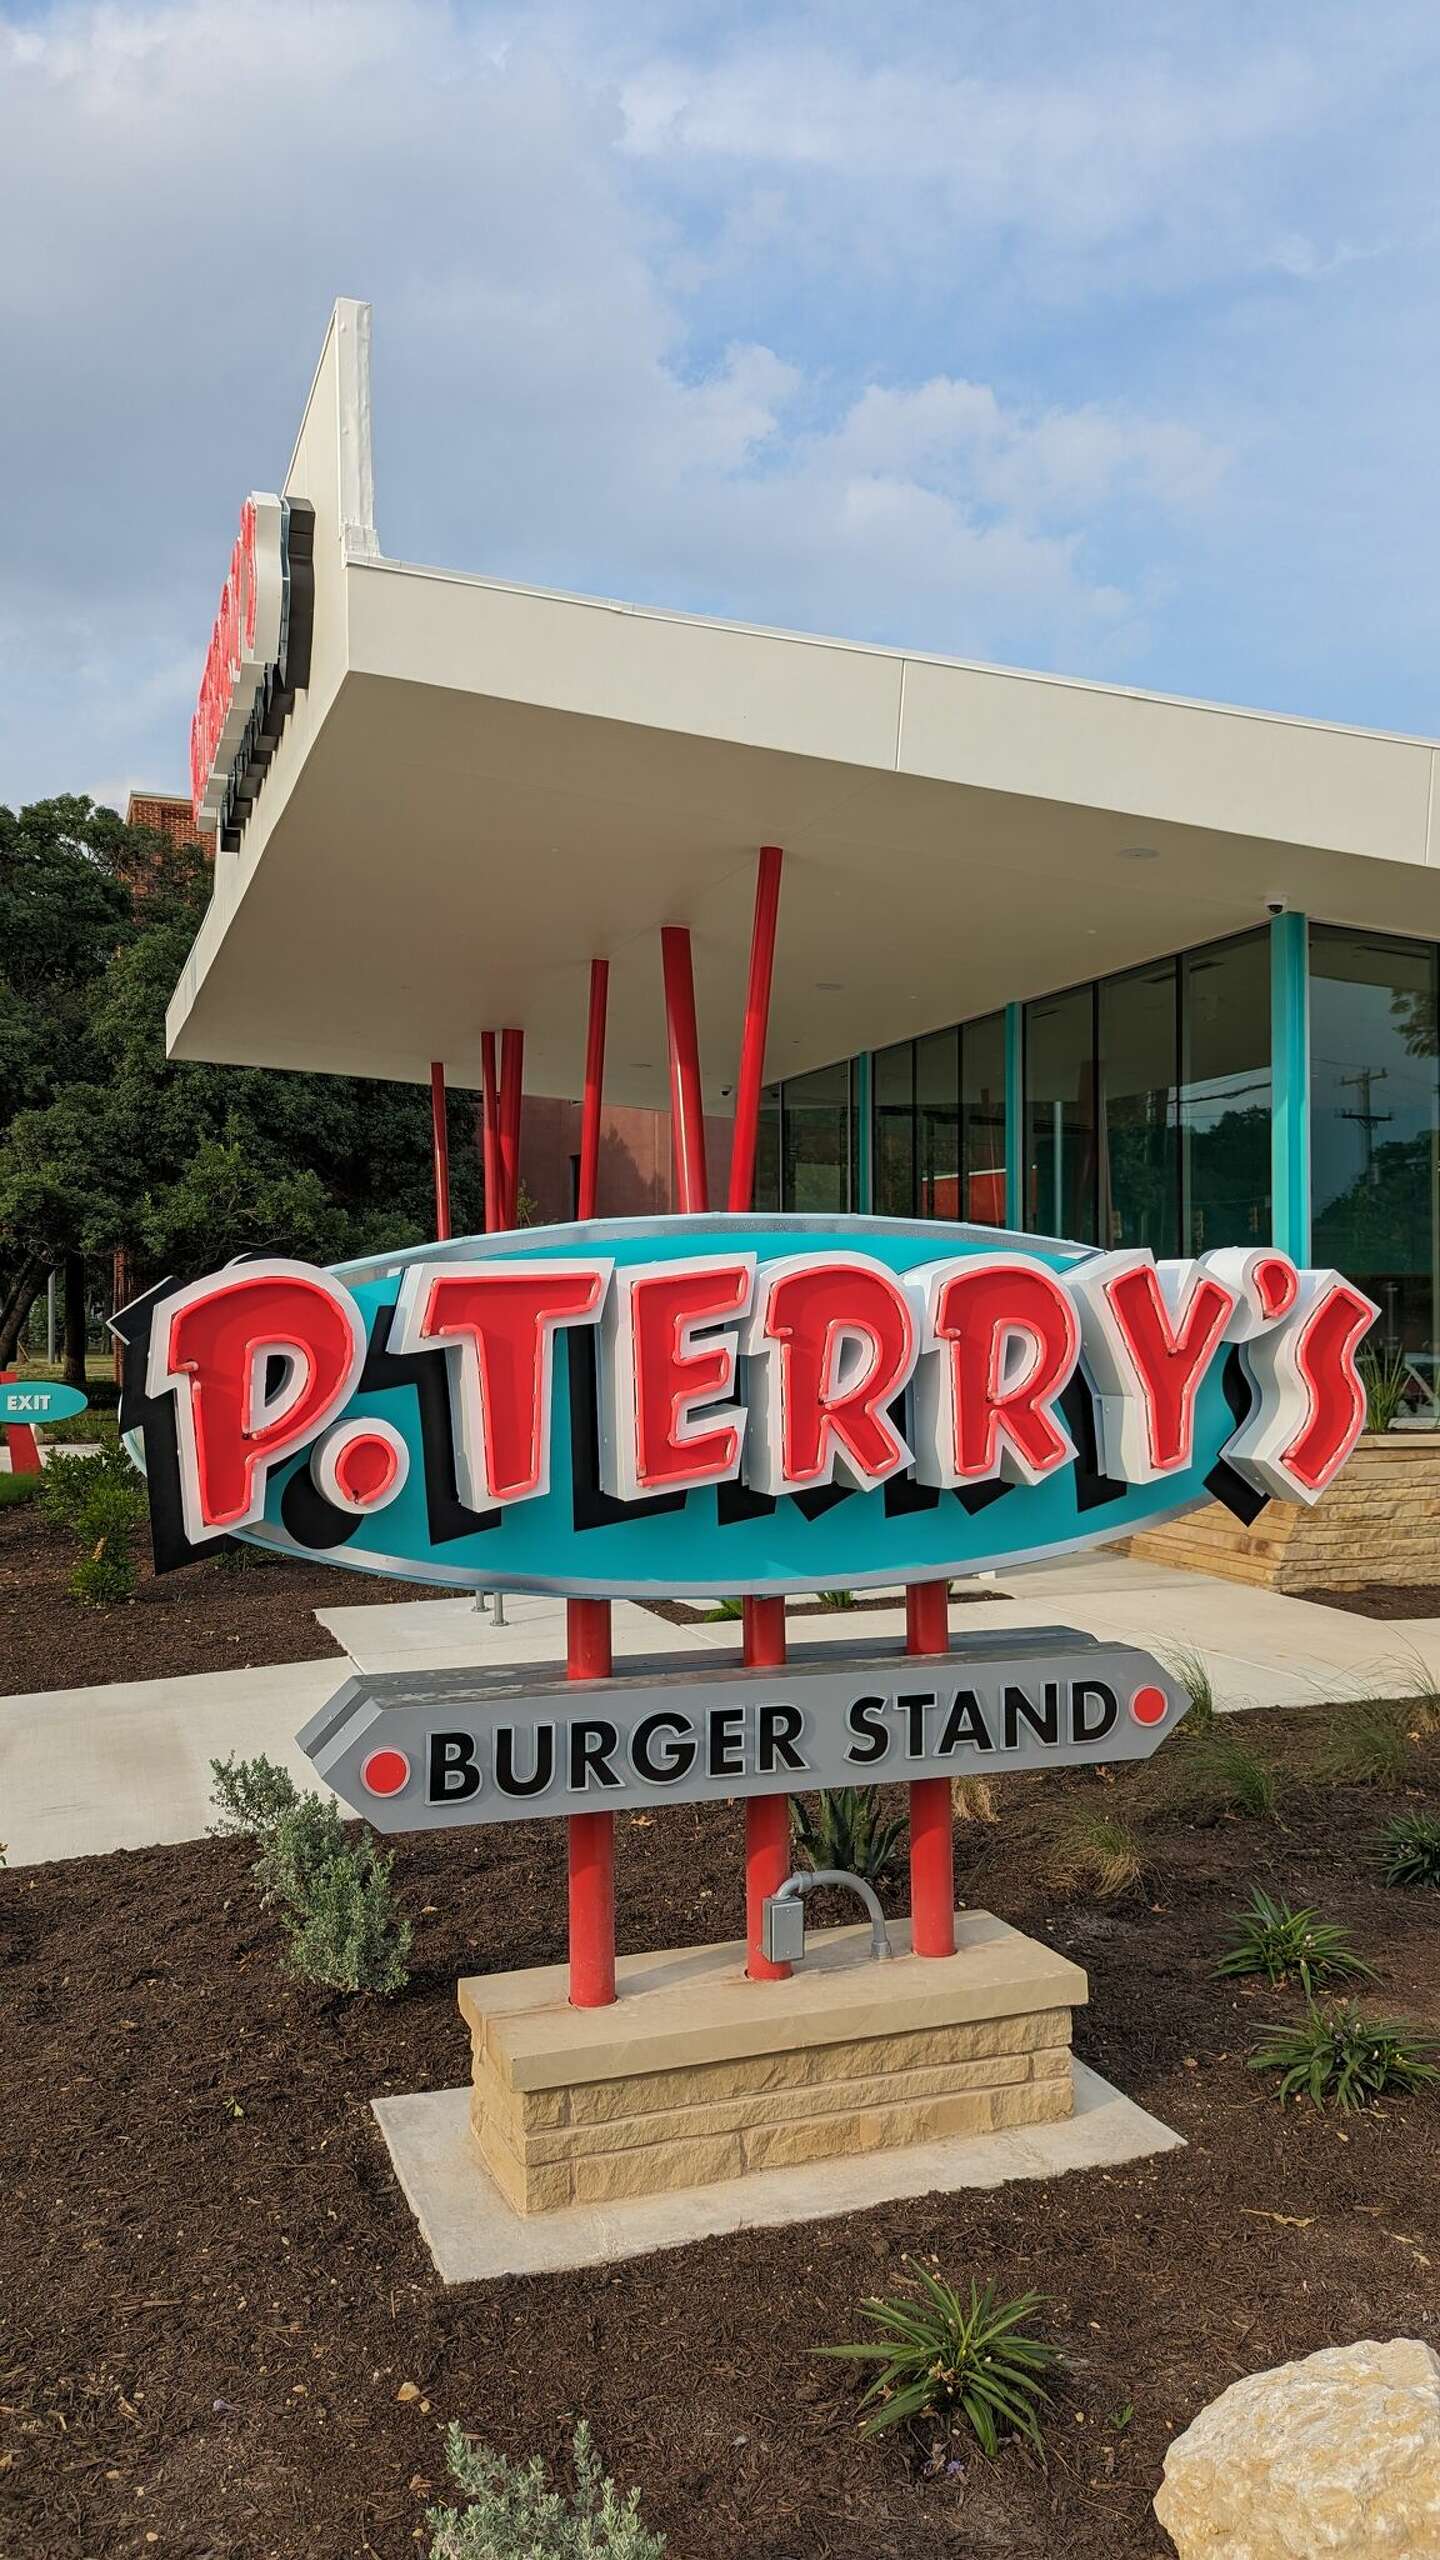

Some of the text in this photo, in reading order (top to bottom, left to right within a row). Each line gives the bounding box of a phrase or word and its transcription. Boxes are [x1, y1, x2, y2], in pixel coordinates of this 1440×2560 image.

[7, 1394, 51, 1411] EXIT
[426, 1680, 1120, 1806] BURGER STAND
